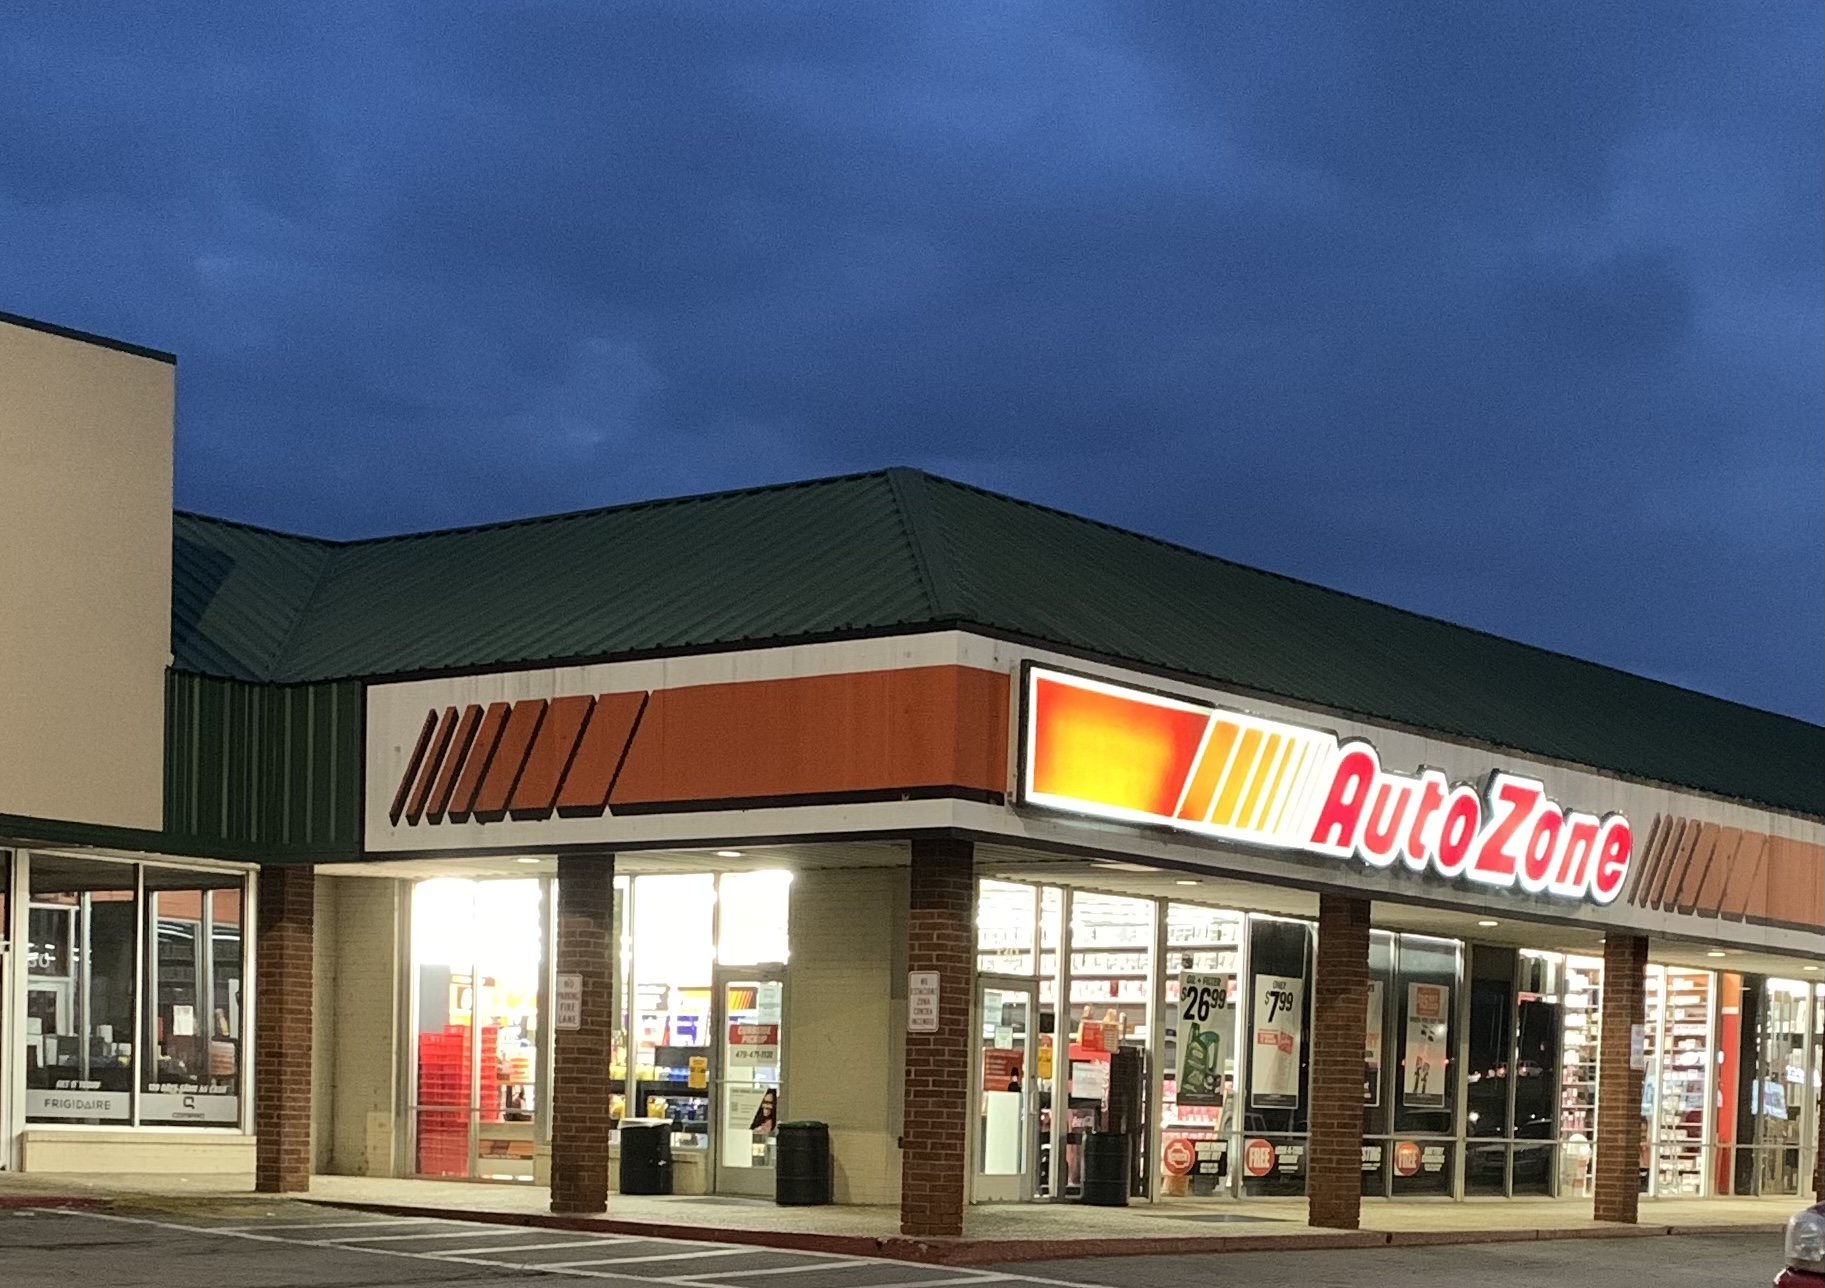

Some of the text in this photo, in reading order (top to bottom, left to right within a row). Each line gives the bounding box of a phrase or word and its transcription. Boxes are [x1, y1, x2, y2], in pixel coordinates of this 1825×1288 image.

[1309, 750, 1632, 893] AutoZone
[560, 1002, 575, 1012] FIRE
[558, 1014, 576, 1024] LANE
[44, 1099, 111, 1110] FRIGIDAIRE
[1249, 1147, 1270, 1168] FREE
[1399, 1152, 1417, 1168] FREE
